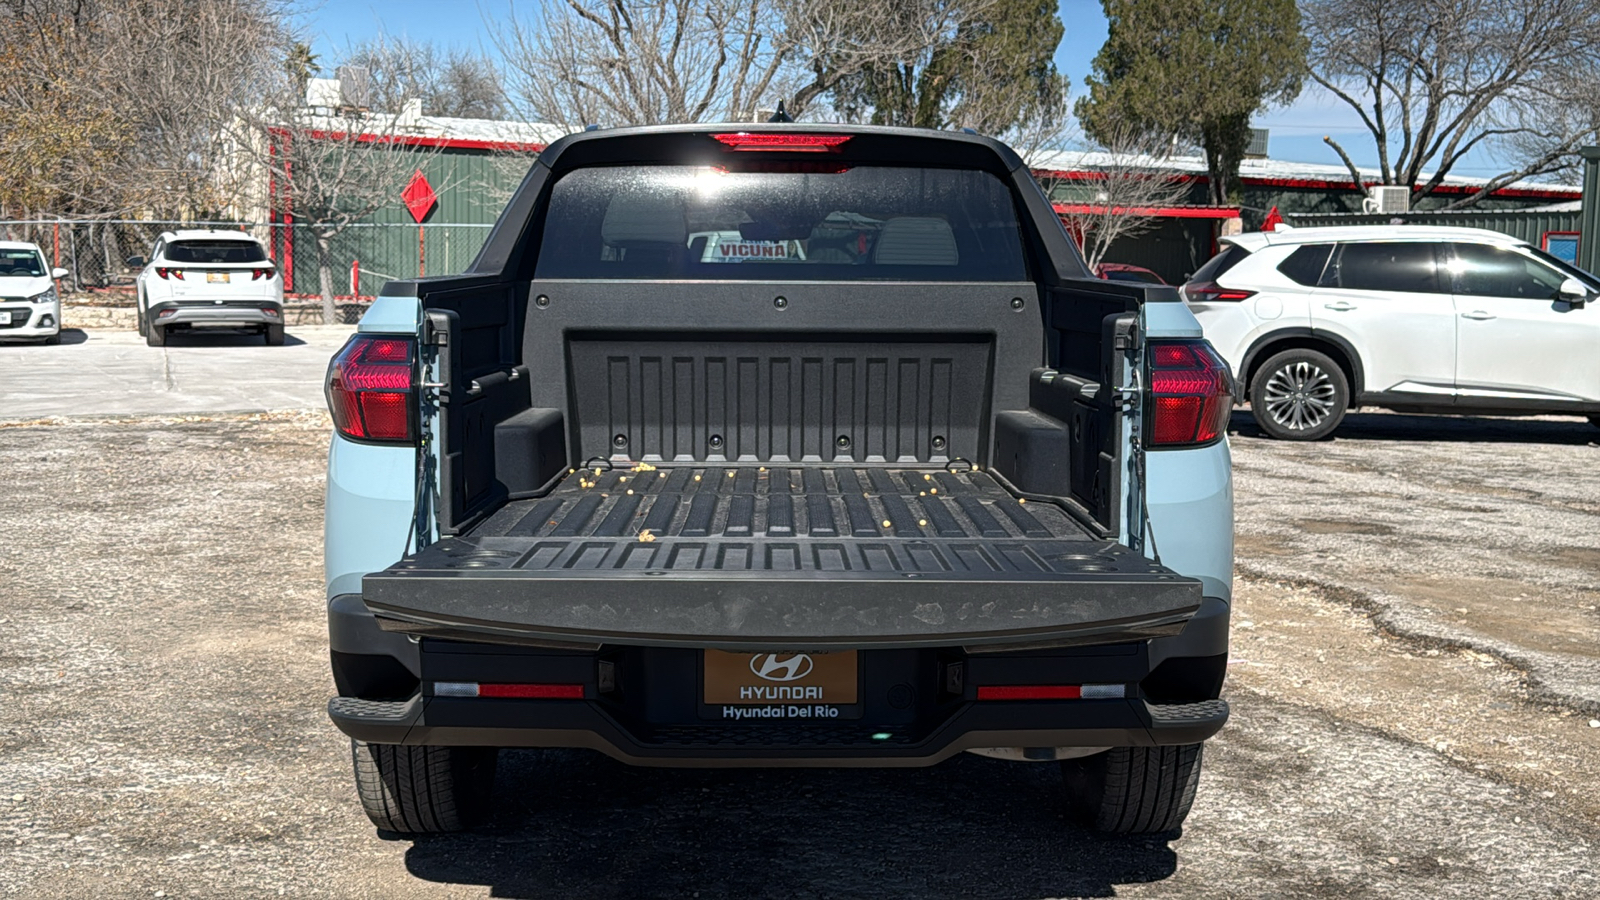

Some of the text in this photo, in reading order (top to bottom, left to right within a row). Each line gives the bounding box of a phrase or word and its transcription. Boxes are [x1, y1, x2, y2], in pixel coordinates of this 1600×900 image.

[740, 686, 823, 700] HYUNDAI
[723, 705, 839, 720] Hyundai Del Rio
